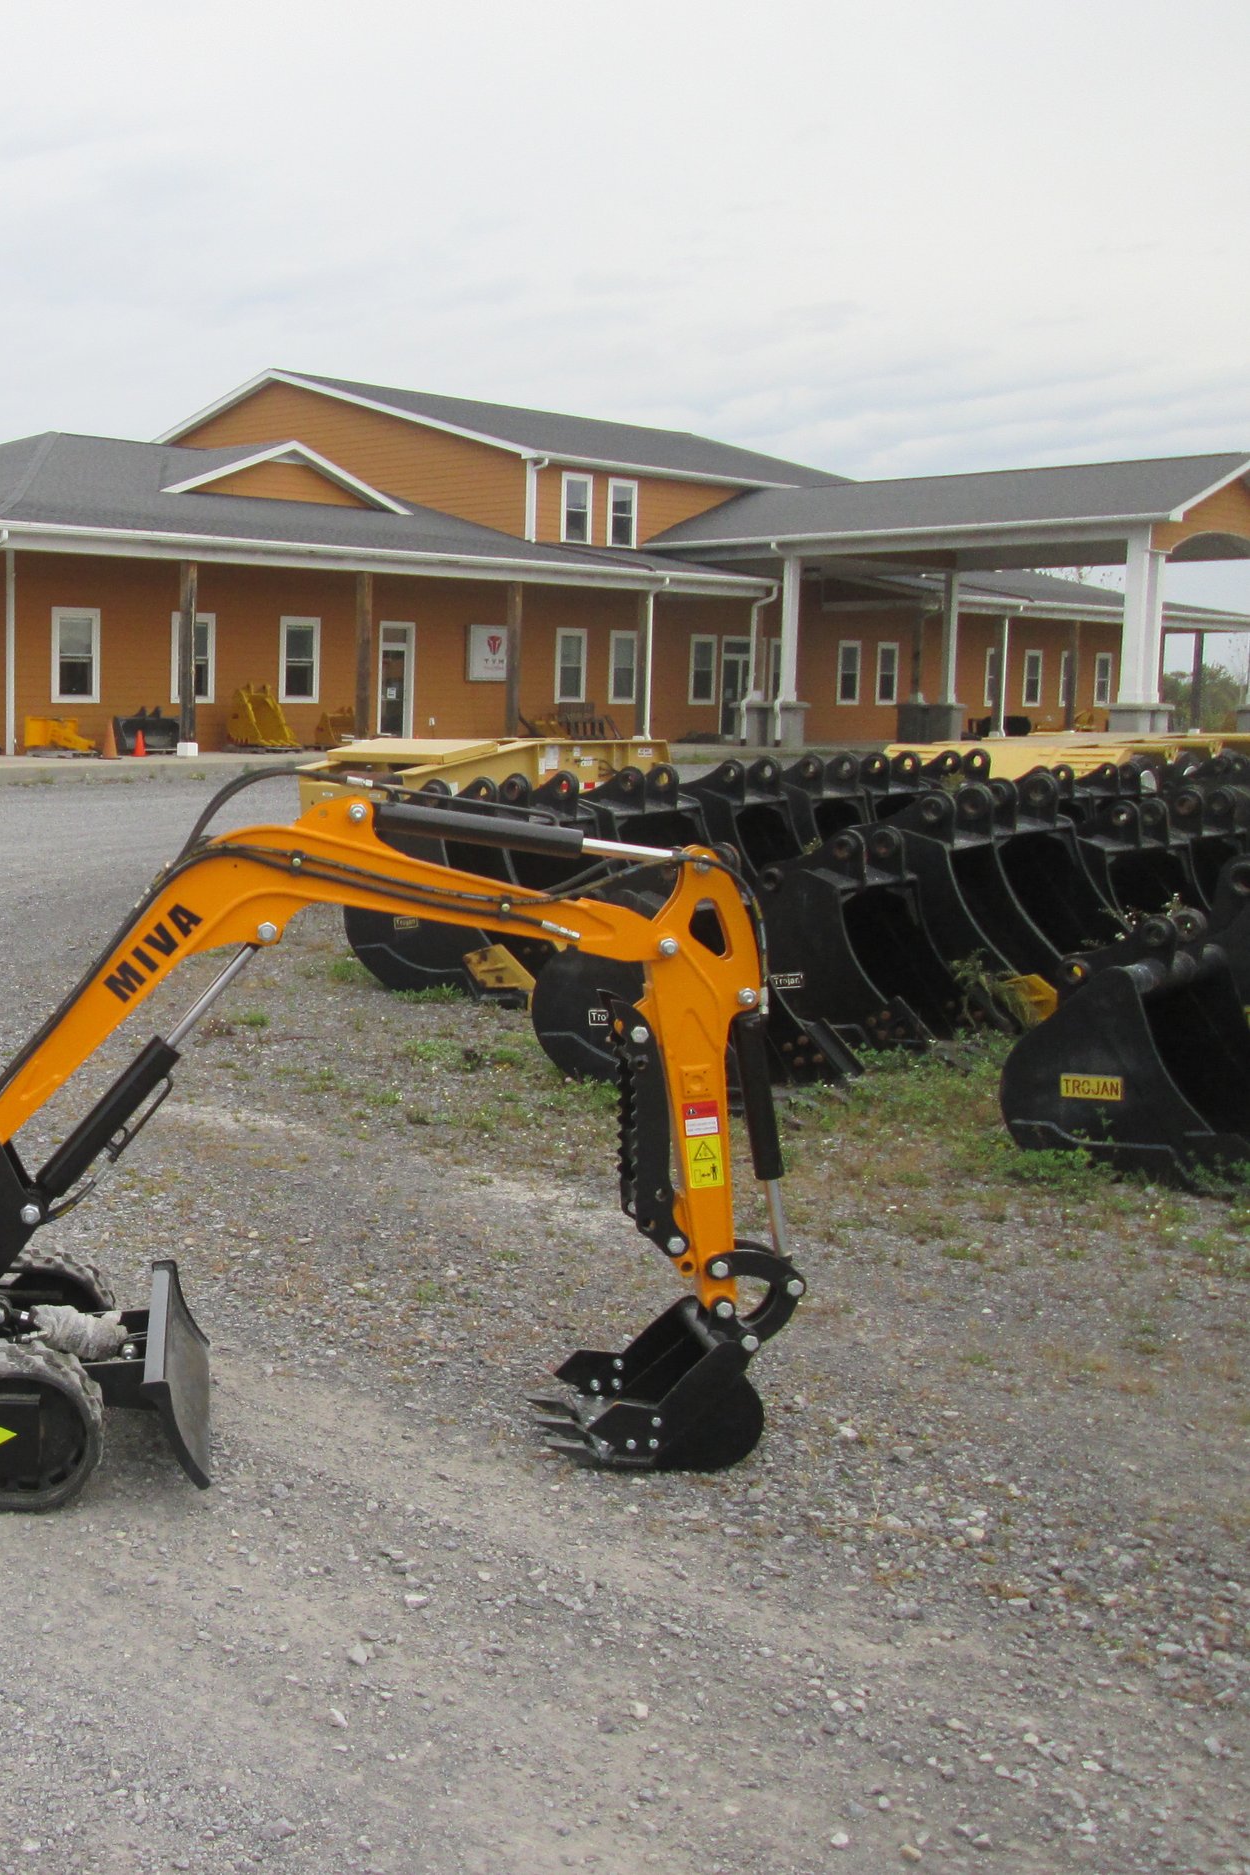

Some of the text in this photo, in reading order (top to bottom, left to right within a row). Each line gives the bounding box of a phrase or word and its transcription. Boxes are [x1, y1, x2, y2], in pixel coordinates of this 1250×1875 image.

[103, 903, 203, 1003] MIVA
[591, 1012, 607, 1021] Tro
[1063, 1078, 1120, 1096] TROJAN
